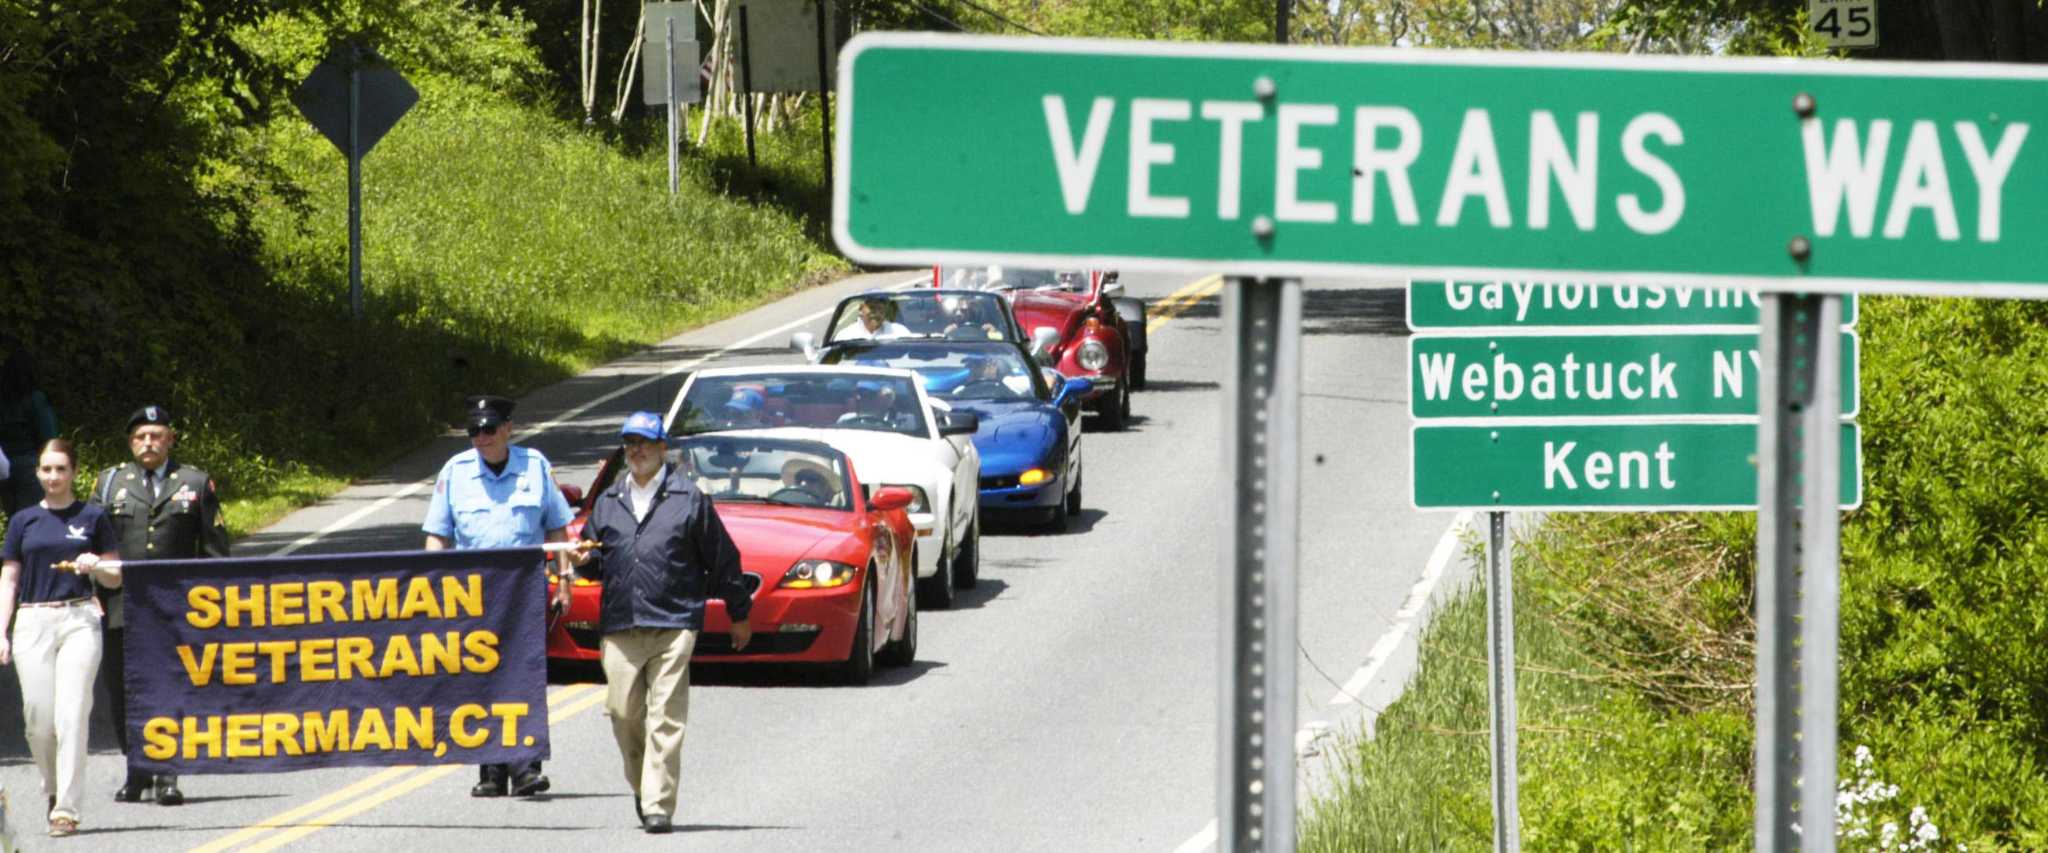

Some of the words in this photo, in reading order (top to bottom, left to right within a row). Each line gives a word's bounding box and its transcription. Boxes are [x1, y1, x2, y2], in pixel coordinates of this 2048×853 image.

[1814, 7, 1871, 38] 45
[1042, 94, 1687, 236] VETERANS
[1801, 116, 2030, 243] WAY
[1445, 281, 1759, 321] Gaylordsv
[1418, 351, 1680, 401] Webatuck
[1543, 440, 1677, 490] Kent
[186, 574, 484, 629] SHERMAN
[176, 629, 501, 686] VETERANS
